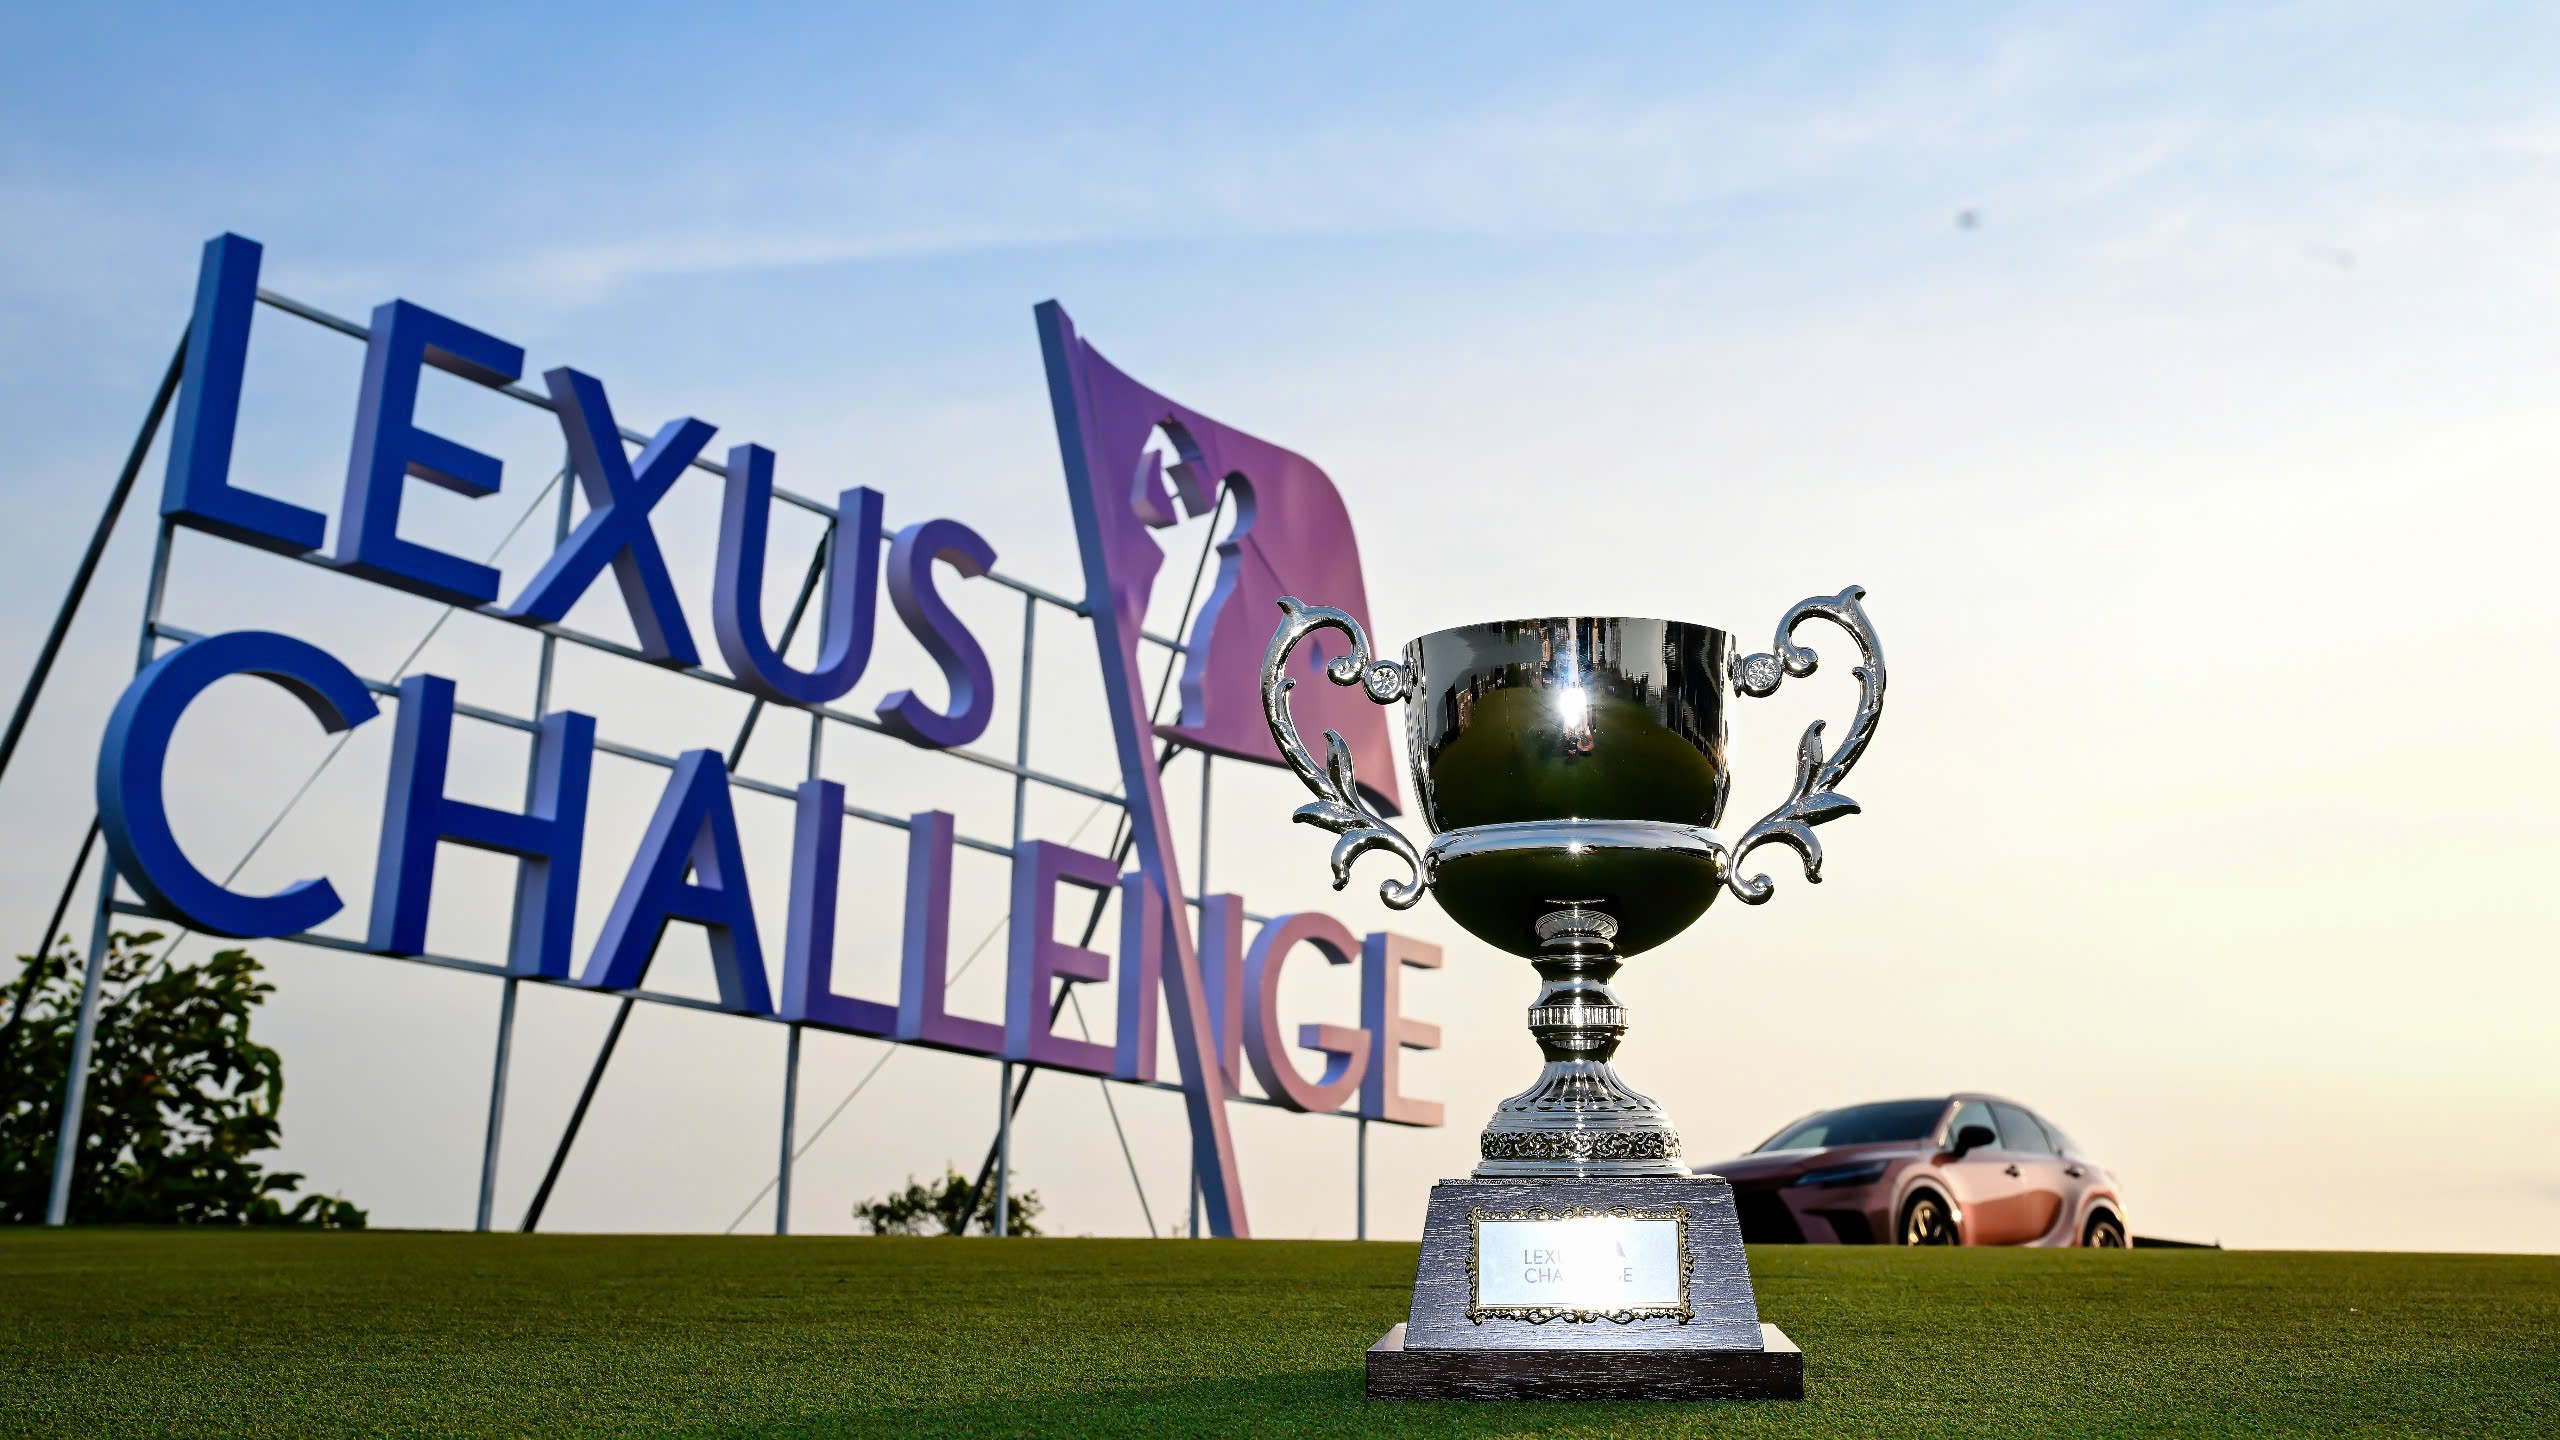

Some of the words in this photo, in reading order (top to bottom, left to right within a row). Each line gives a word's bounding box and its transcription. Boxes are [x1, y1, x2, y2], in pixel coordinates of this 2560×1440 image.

[162, 231, 997, 750] LEXUS
[97, 630, 1445, 1127] CHALLENGE
[1523, 1249, 1566, 1265] LEX
